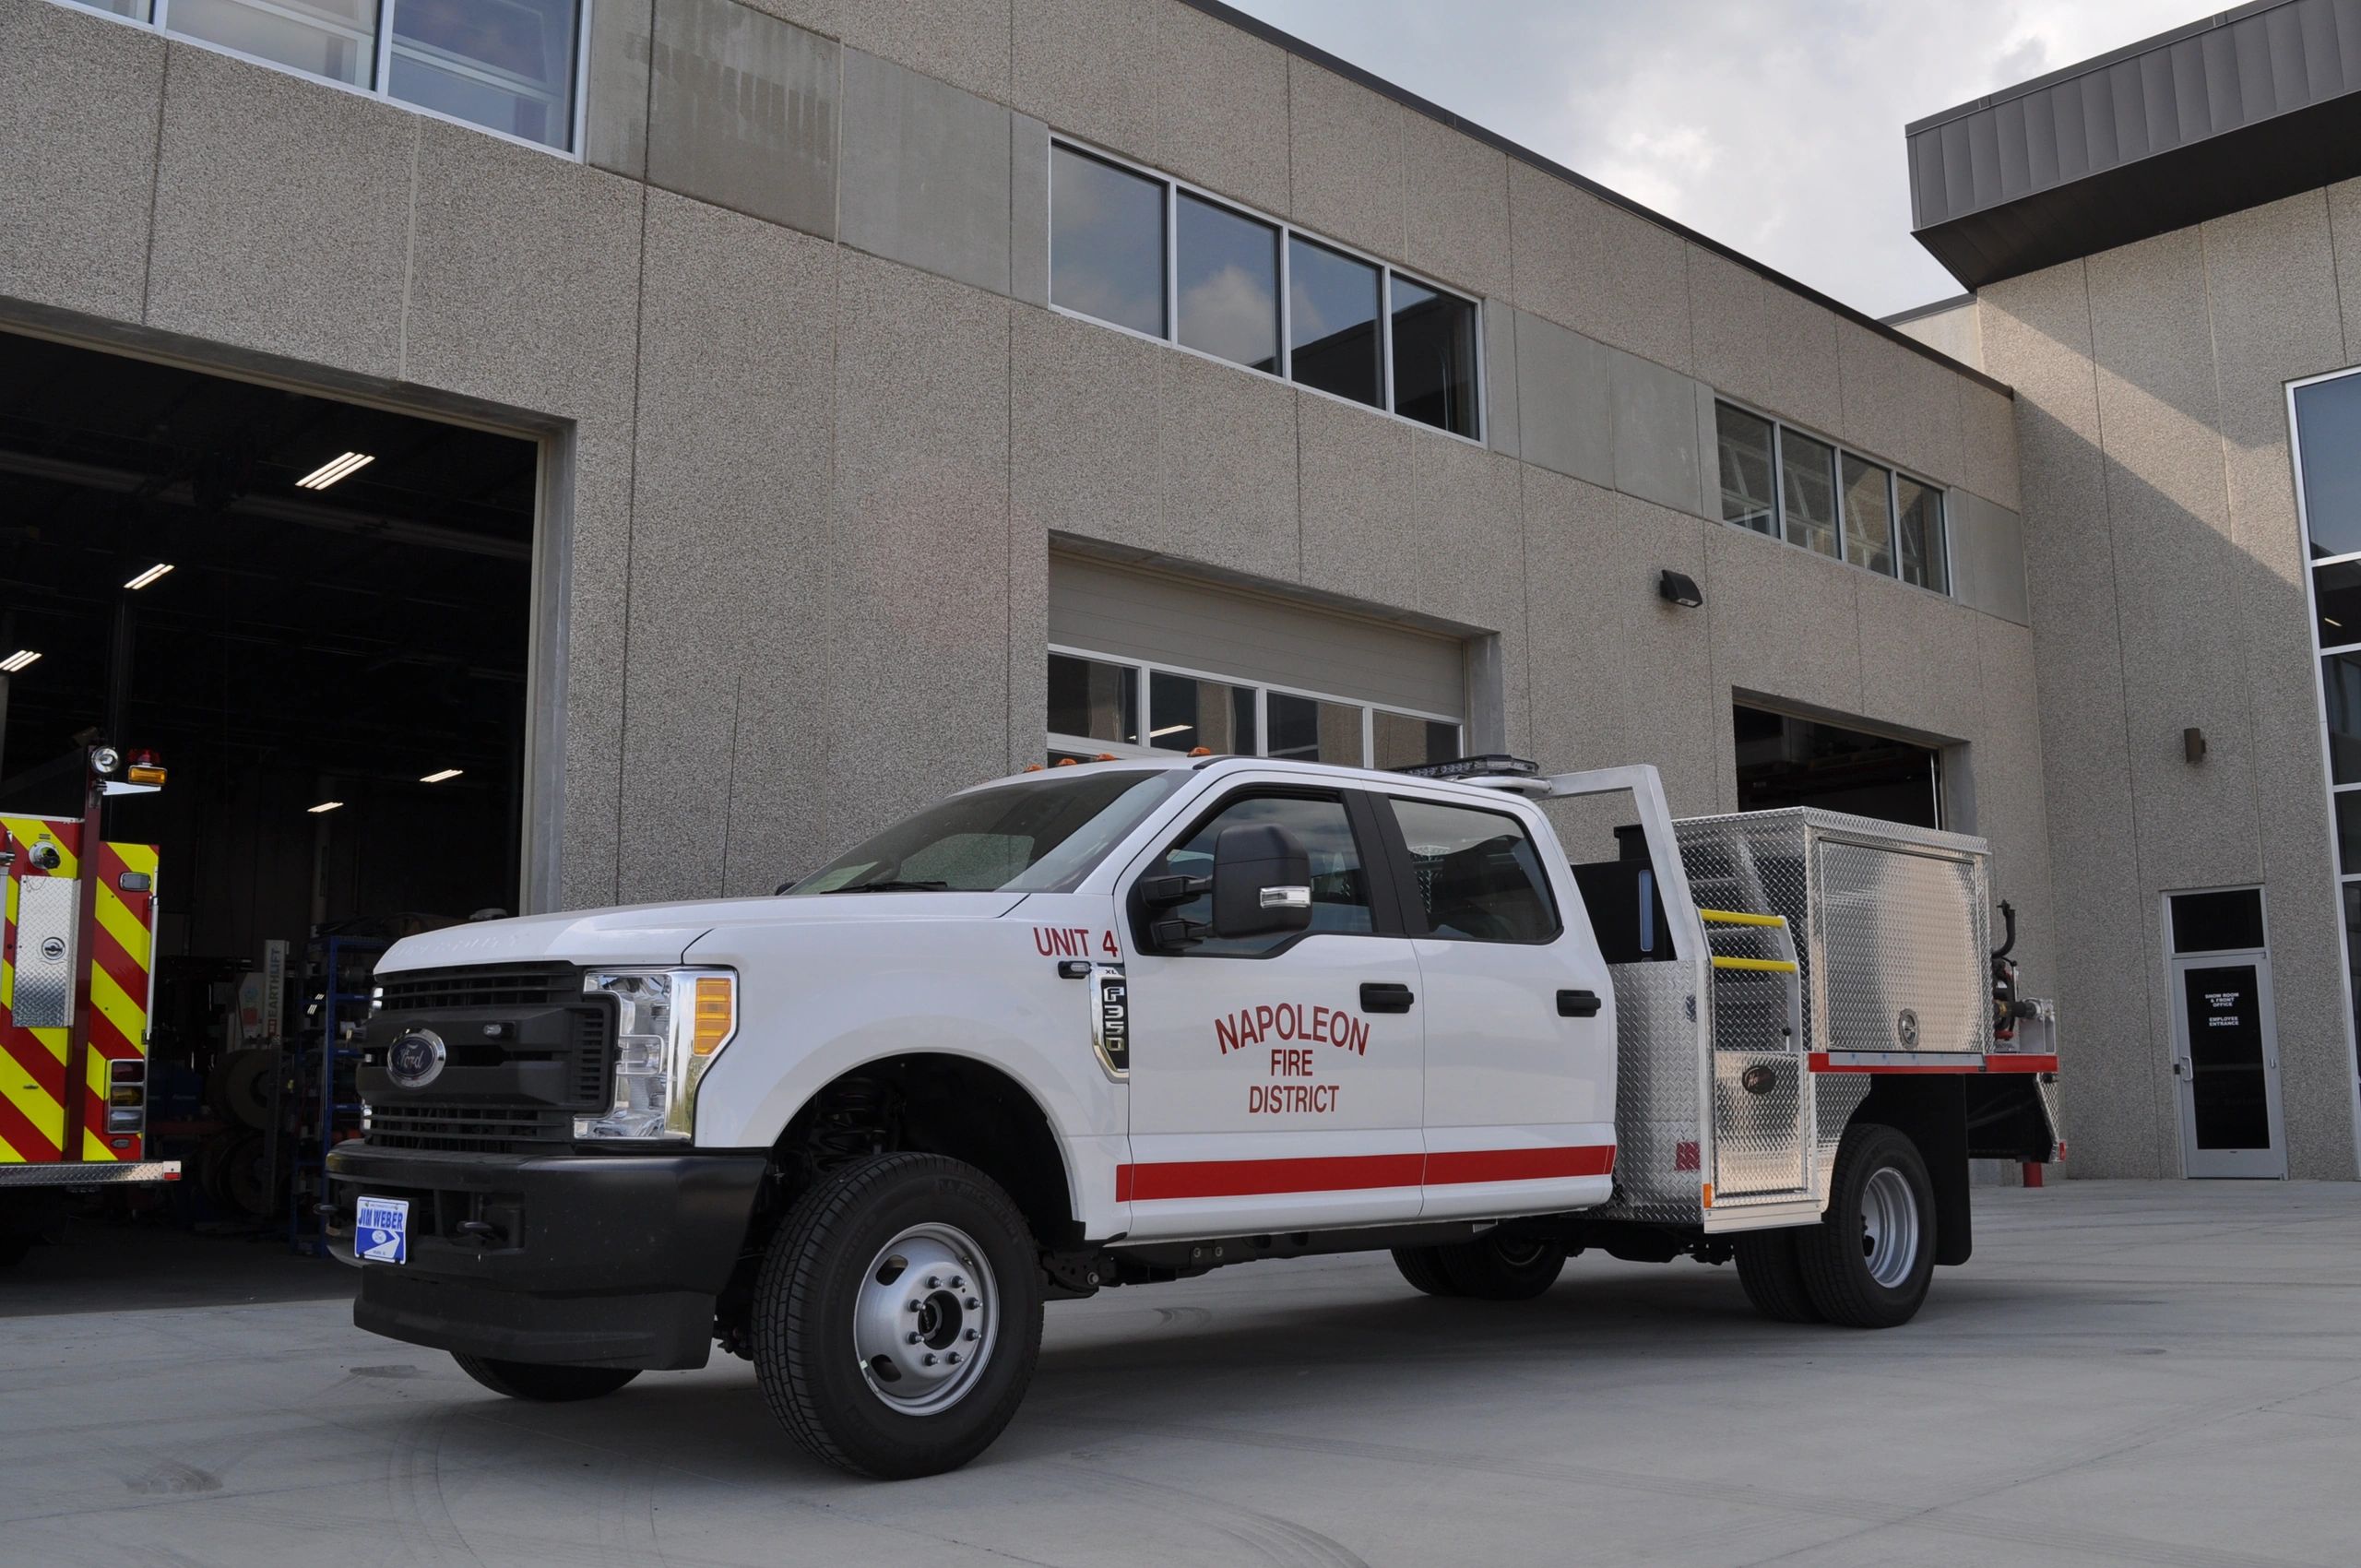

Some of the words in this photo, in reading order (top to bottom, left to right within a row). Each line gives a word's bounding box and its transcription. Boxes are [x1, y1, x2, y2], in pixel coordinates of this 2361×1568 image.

[1033, 927, 1089, 956] UNIT
[1102, 930, 1118, 957] 4
[267, 947, 279, 1018] EARTHLIFT
[1103, 986, 1125, 1051] F350
[1215, 1003, 1370, 1056] NAPOLEON
[1271, 1049, 1313, 1076] FIRE
[1249, 1085, 1340, 1113] DISTRICT
[358, 1207, 373, 1226] JIM
[374, 1209, 404, 1230] WEBER
